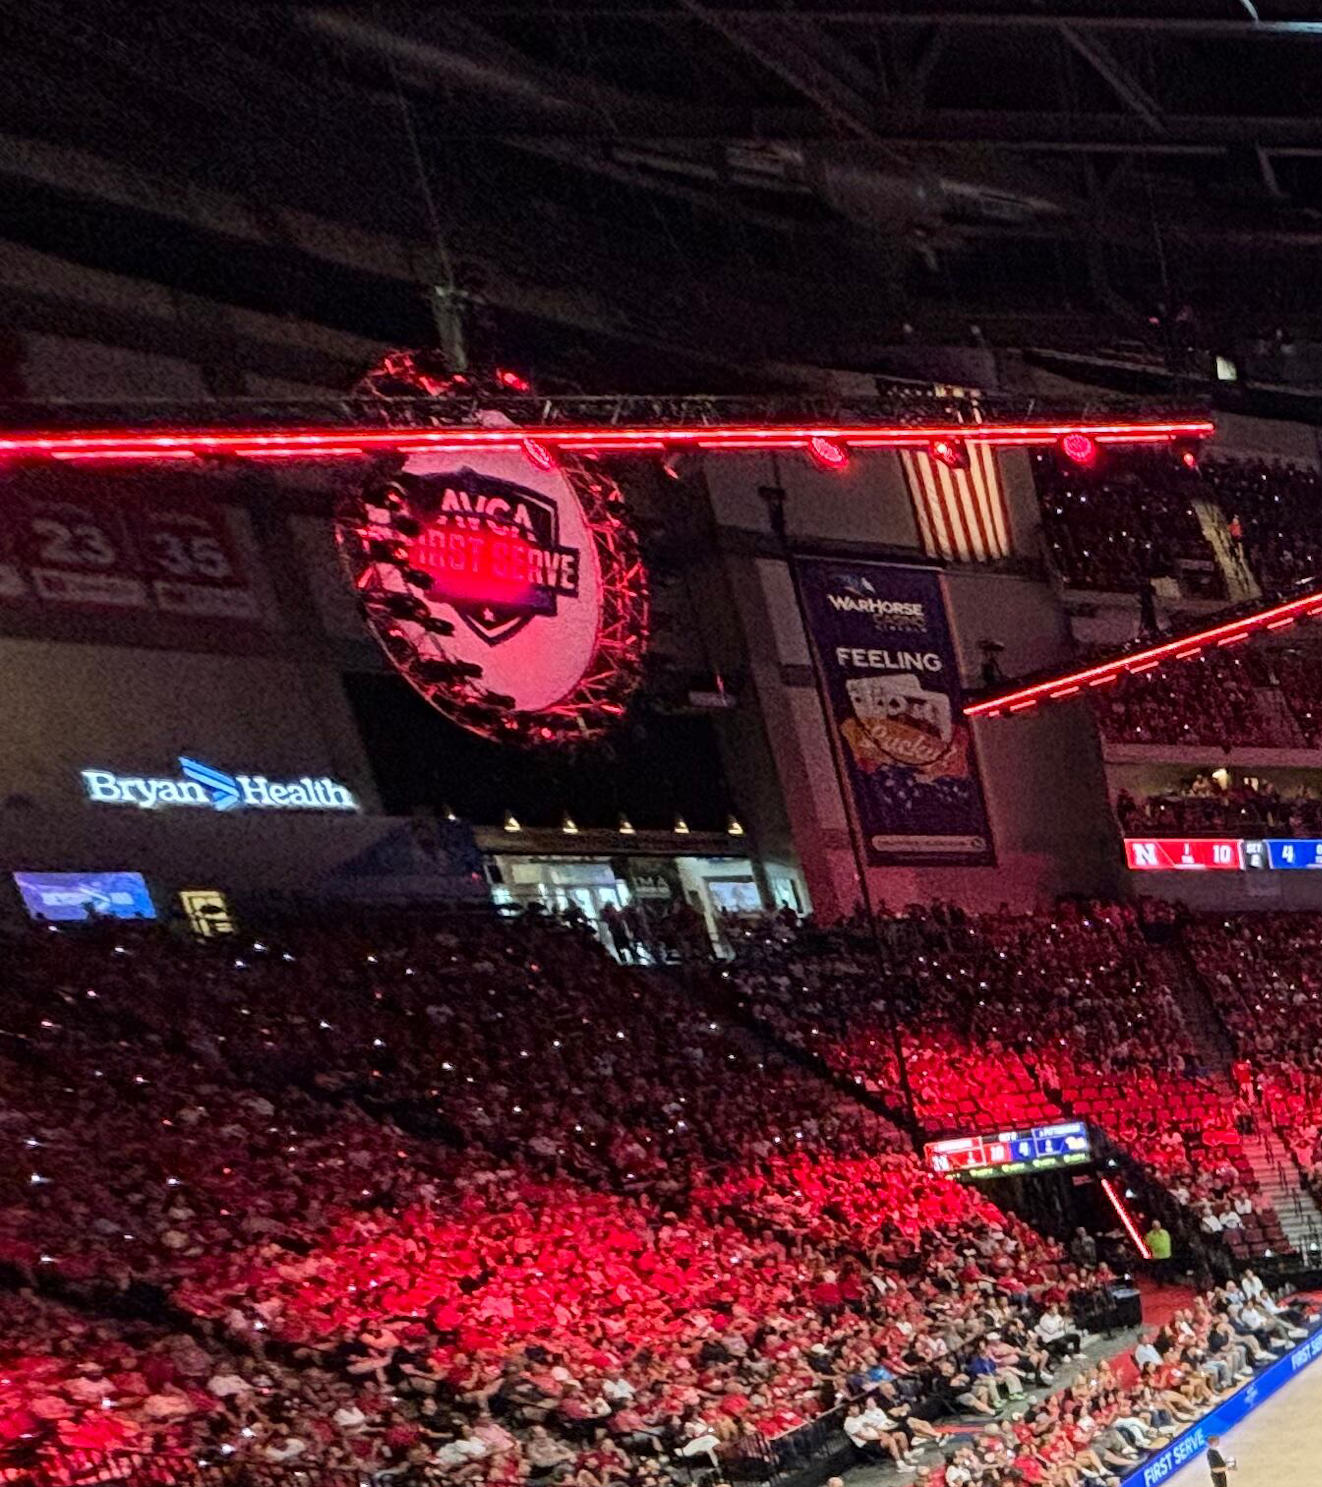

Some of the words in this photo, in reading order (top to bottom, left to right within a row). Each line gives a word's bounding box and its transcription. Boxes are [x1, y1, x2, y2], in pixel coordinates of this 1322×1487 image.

[437, 487, 538, 545] AVCA
[416, 528, 485, 574] IRST
[491, 541, 576, 591] SERVE
[836, 647, 943, 672] FEELING
[81, 769, 210, 808] Bryan
[235, 775, 360, 809] Health
[1132, 843, 1159, 865] N
[1213, 845, 1231, 863] 10
[1281, 845, 1294, 863] 4
[1173, 1425, 1206, 1471] SERVE
